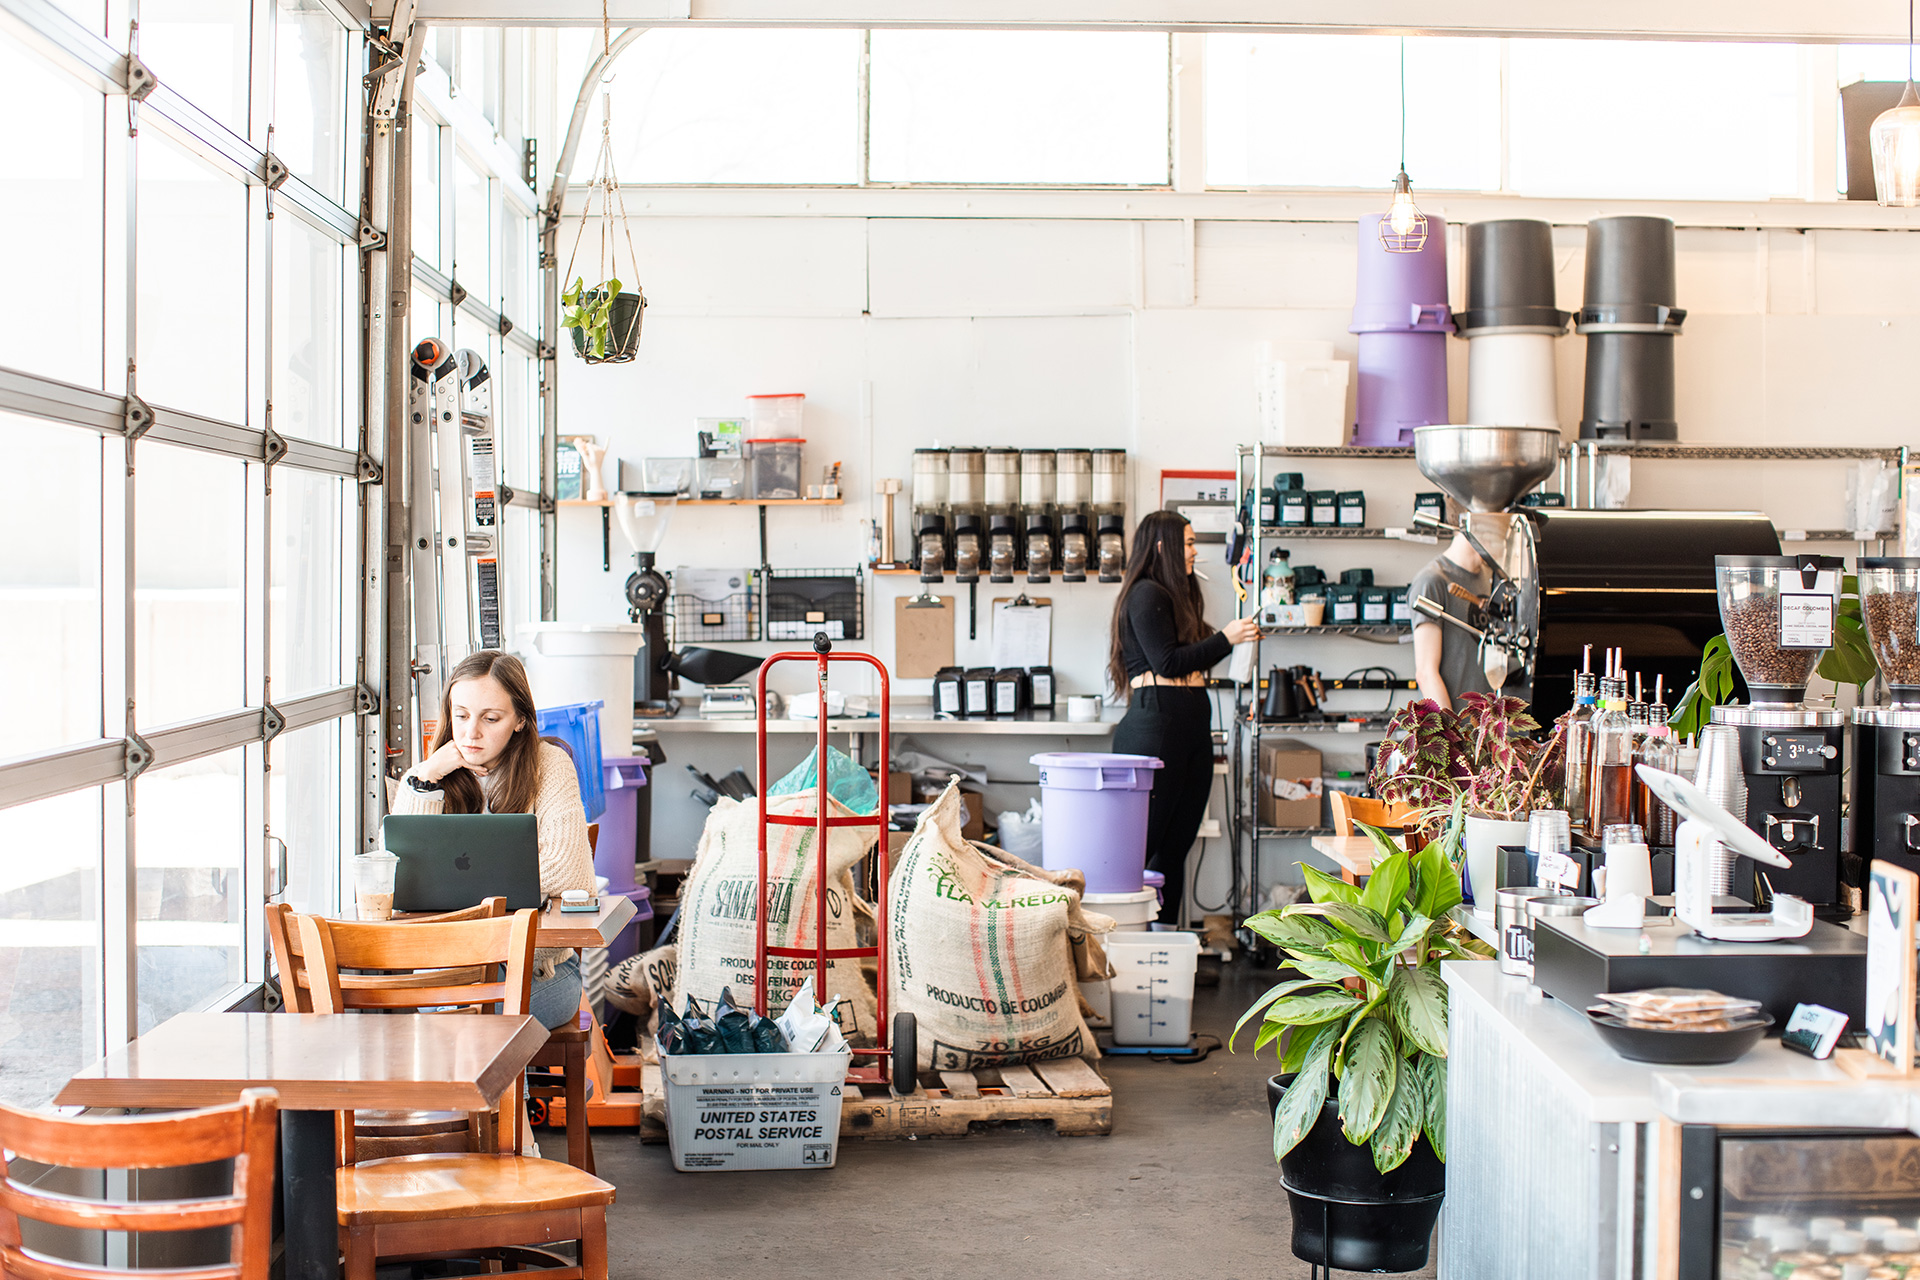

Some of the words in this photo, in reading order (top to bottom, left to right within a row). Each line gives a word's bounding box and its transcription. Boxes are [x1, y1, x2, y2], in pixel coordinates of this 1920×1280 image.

[1316, 497, 1332, 505] LOST
[1344, 497, 1360, 505] LOST
[1545, 498, 1560, 506] LOST
[1338, 594, 1353, 602] LOST
[906, 851, 921, 888] INSIDE
[894, 899, 902, 923] NOT
[898, 875, 907, 896] USE
[904, 836, 924, 872] HOOKS
[901, 890, 911, 913] BAG
[719, 957, 774, 970] PRODUO
[775, 960, 789, 970] DE
[790, 960, 836, 971] COLOIA
[901, 941, 913, 978] GRAIN
[735, 973, 808, 987] DESFEINAD
[926, 983, 997, 1014] PRODUCTO
[1000, 1001, 1019, 1015] DE
[1021, 981, 1068, 1014] COLOMBIA
[976, 1040, 1010, 1051] 70
[1018, 1036, 1051, 1050] KG
[944, 1052, 959, 1069] 3
[700, 1111, 755, 1124] UNITED
[758, 1110, 817, 1123] STATES
[694, 1128, 753, 1140] POSTAL
[758, 1126, 823, 1139] SERVICE
